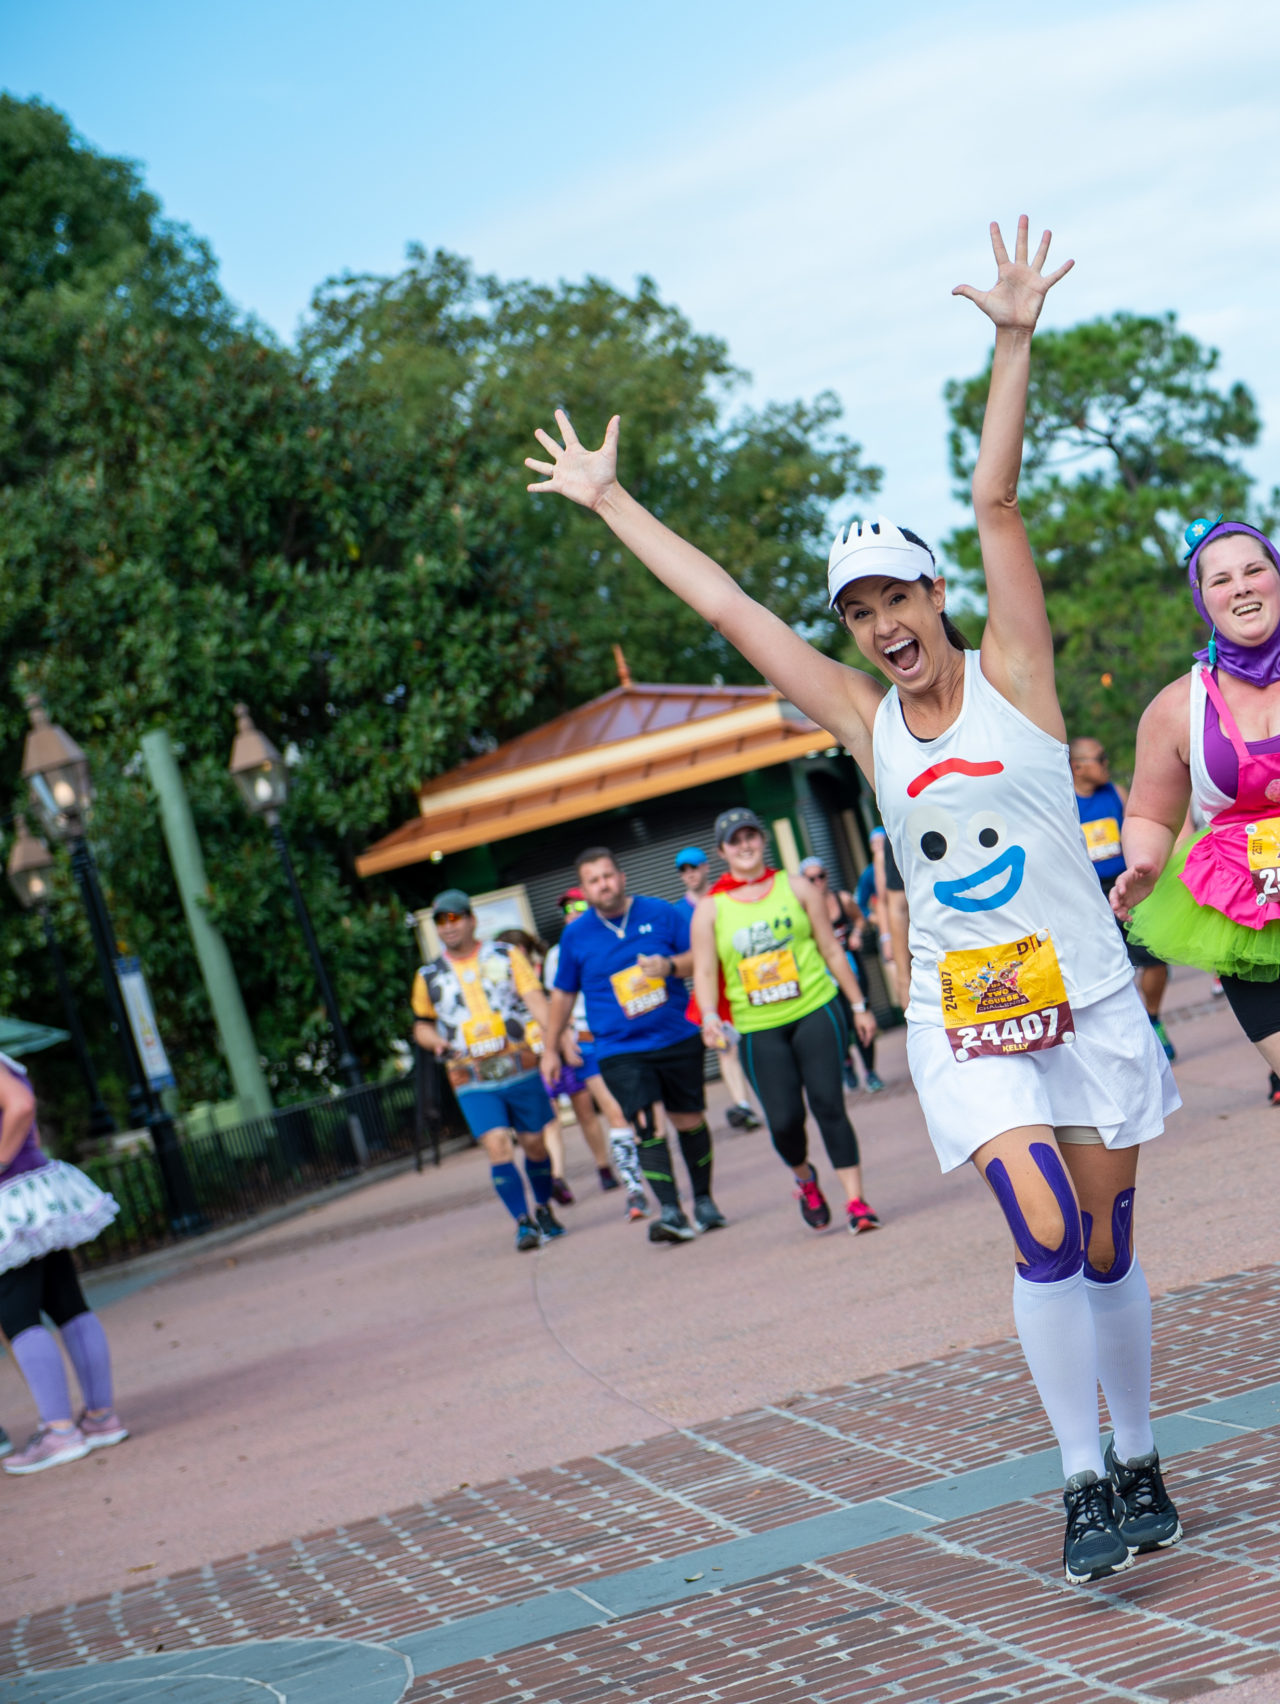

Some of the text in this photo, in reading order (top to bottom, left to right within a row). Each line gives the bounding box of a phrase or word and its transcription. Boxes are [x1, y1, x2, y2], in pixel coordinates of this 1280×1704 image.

[941, 971, 958, 1012] 24407
[987, 988, 1009, 998] TWO
[982, 993, 1019, 1006] COURSE
[957, 1007, 1059, 1049] 24407
[1002, 1043, 1030, 1052] KELLY
